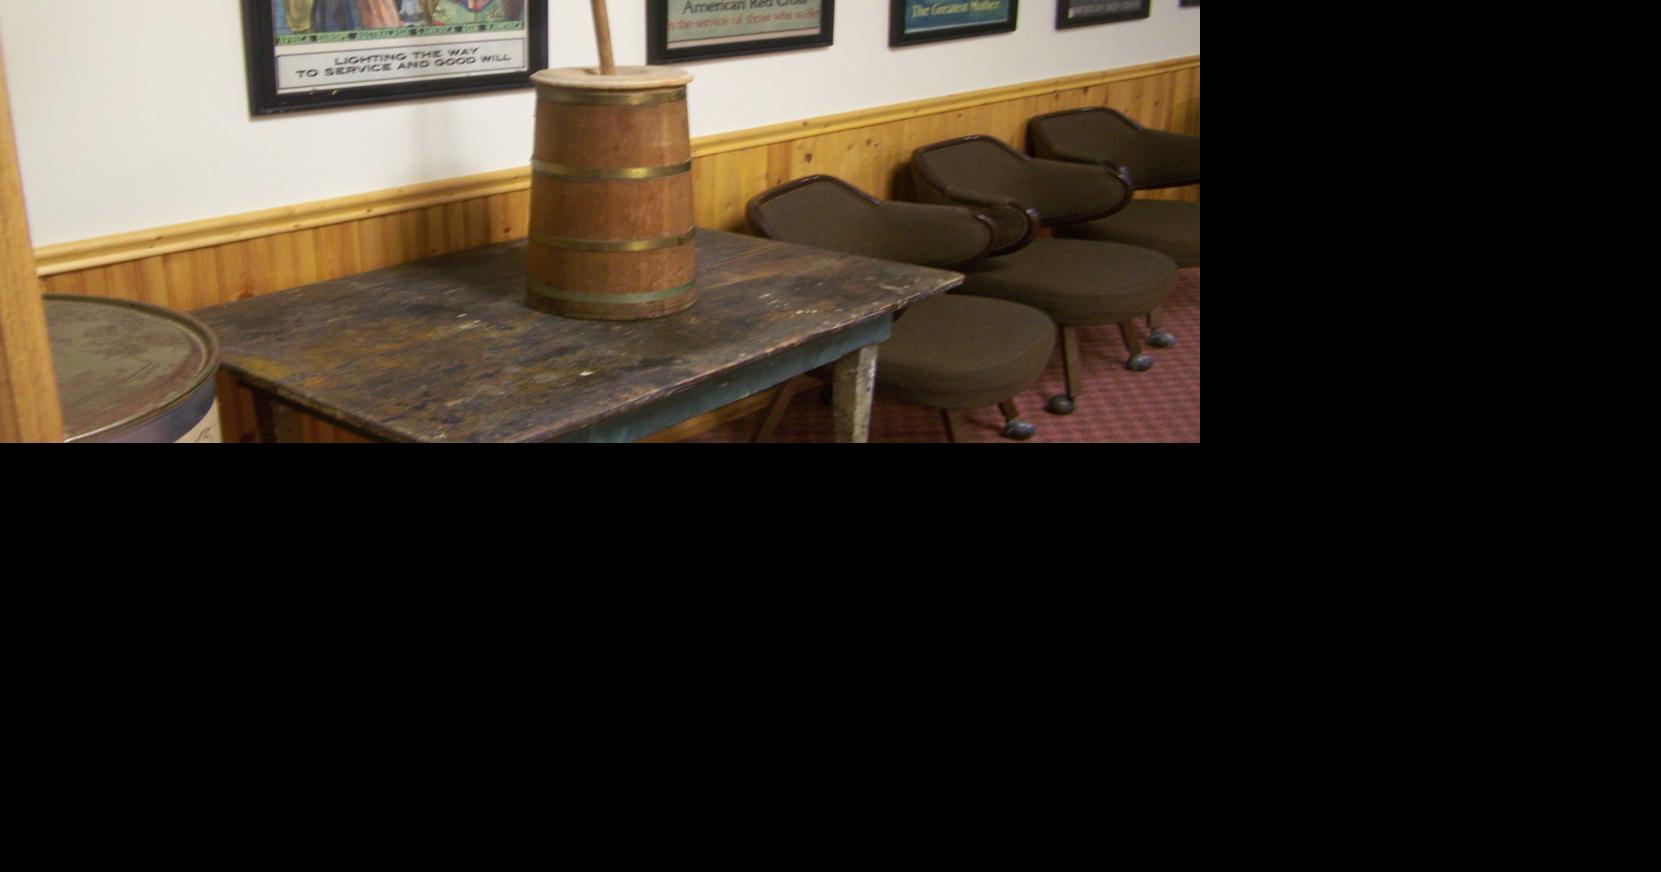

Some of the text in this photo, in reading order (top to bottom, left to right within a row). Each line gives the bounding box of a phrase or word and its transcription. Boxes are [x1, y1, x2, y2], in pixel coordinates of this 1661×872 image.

[681, 0, 745, 14] American
[911, 5, 929, 17] The
[930, 3, 968, 16] Greatest
[334, 47, 479, 65] LIGHTING THE WAY
[296, 54, 512, 78] TO SERVICE AND GOOD WILL
